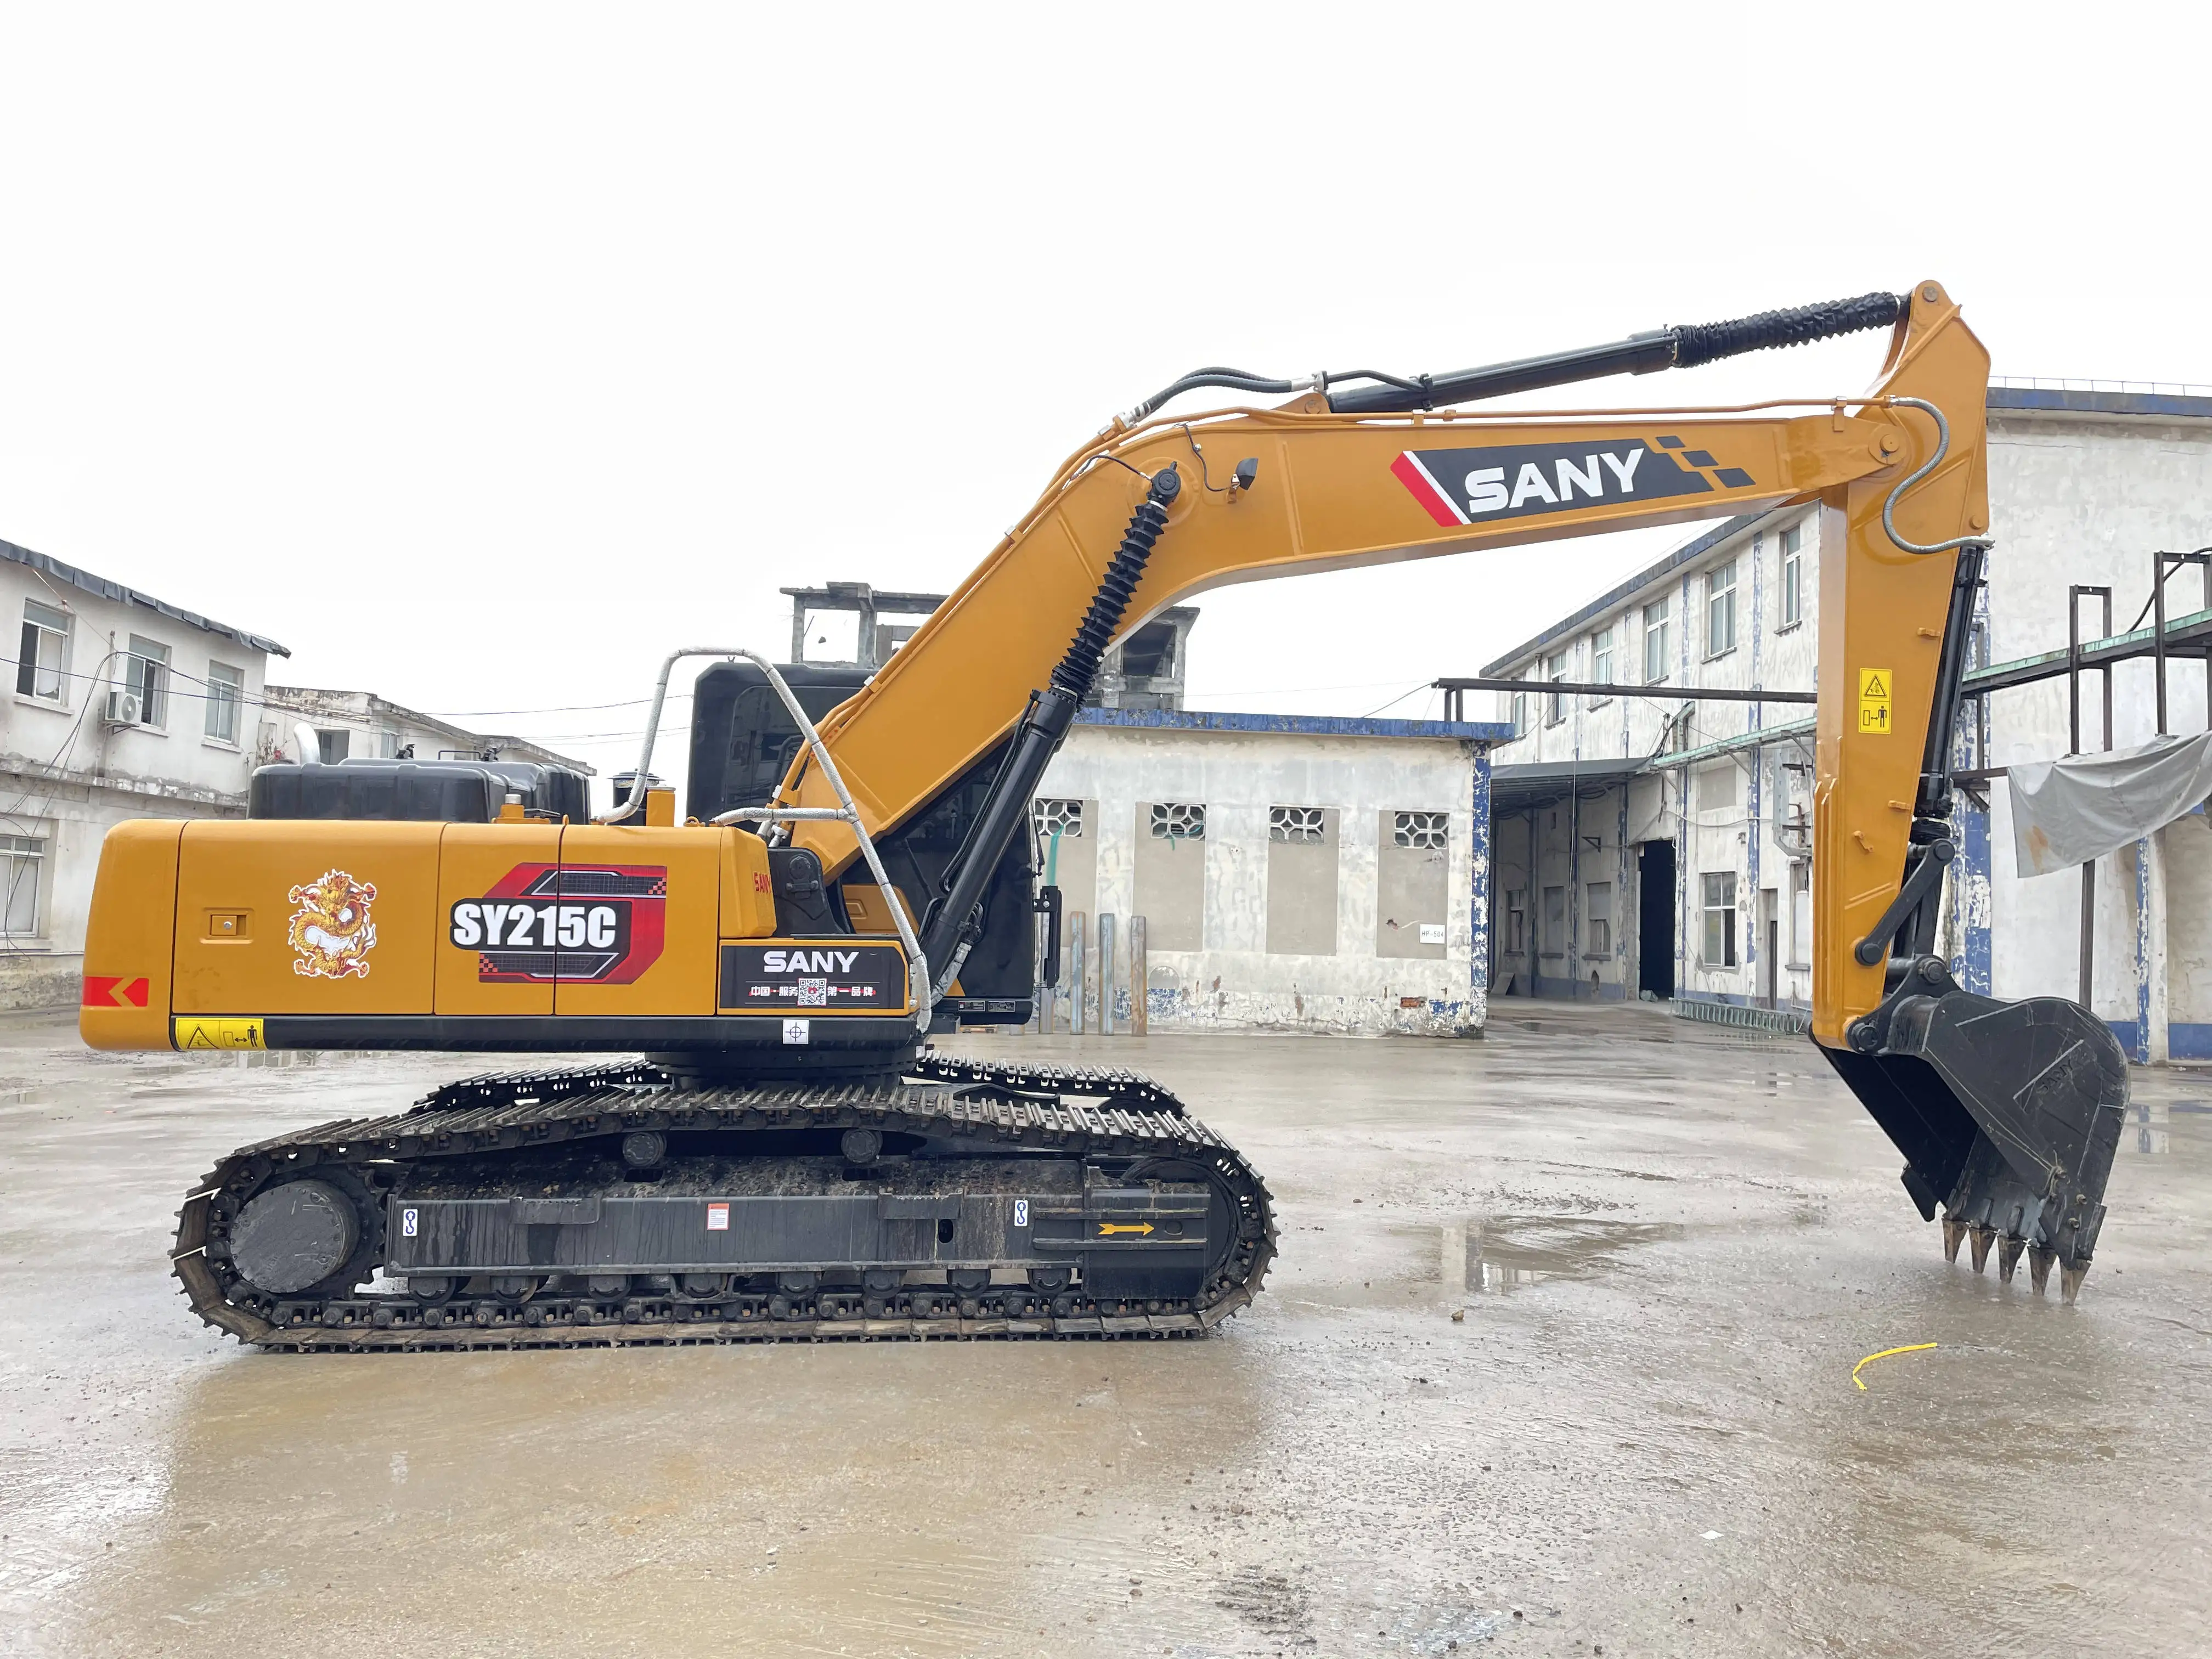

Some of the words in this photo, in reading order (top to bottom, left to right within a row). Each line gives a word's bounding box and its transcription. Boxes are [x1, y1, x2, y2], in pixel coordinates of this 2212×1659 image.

[1465, 448, 1644, 514] SANY
[454, 904, 617, 948] SY215C
[764, 951, 859, 973] SANY
